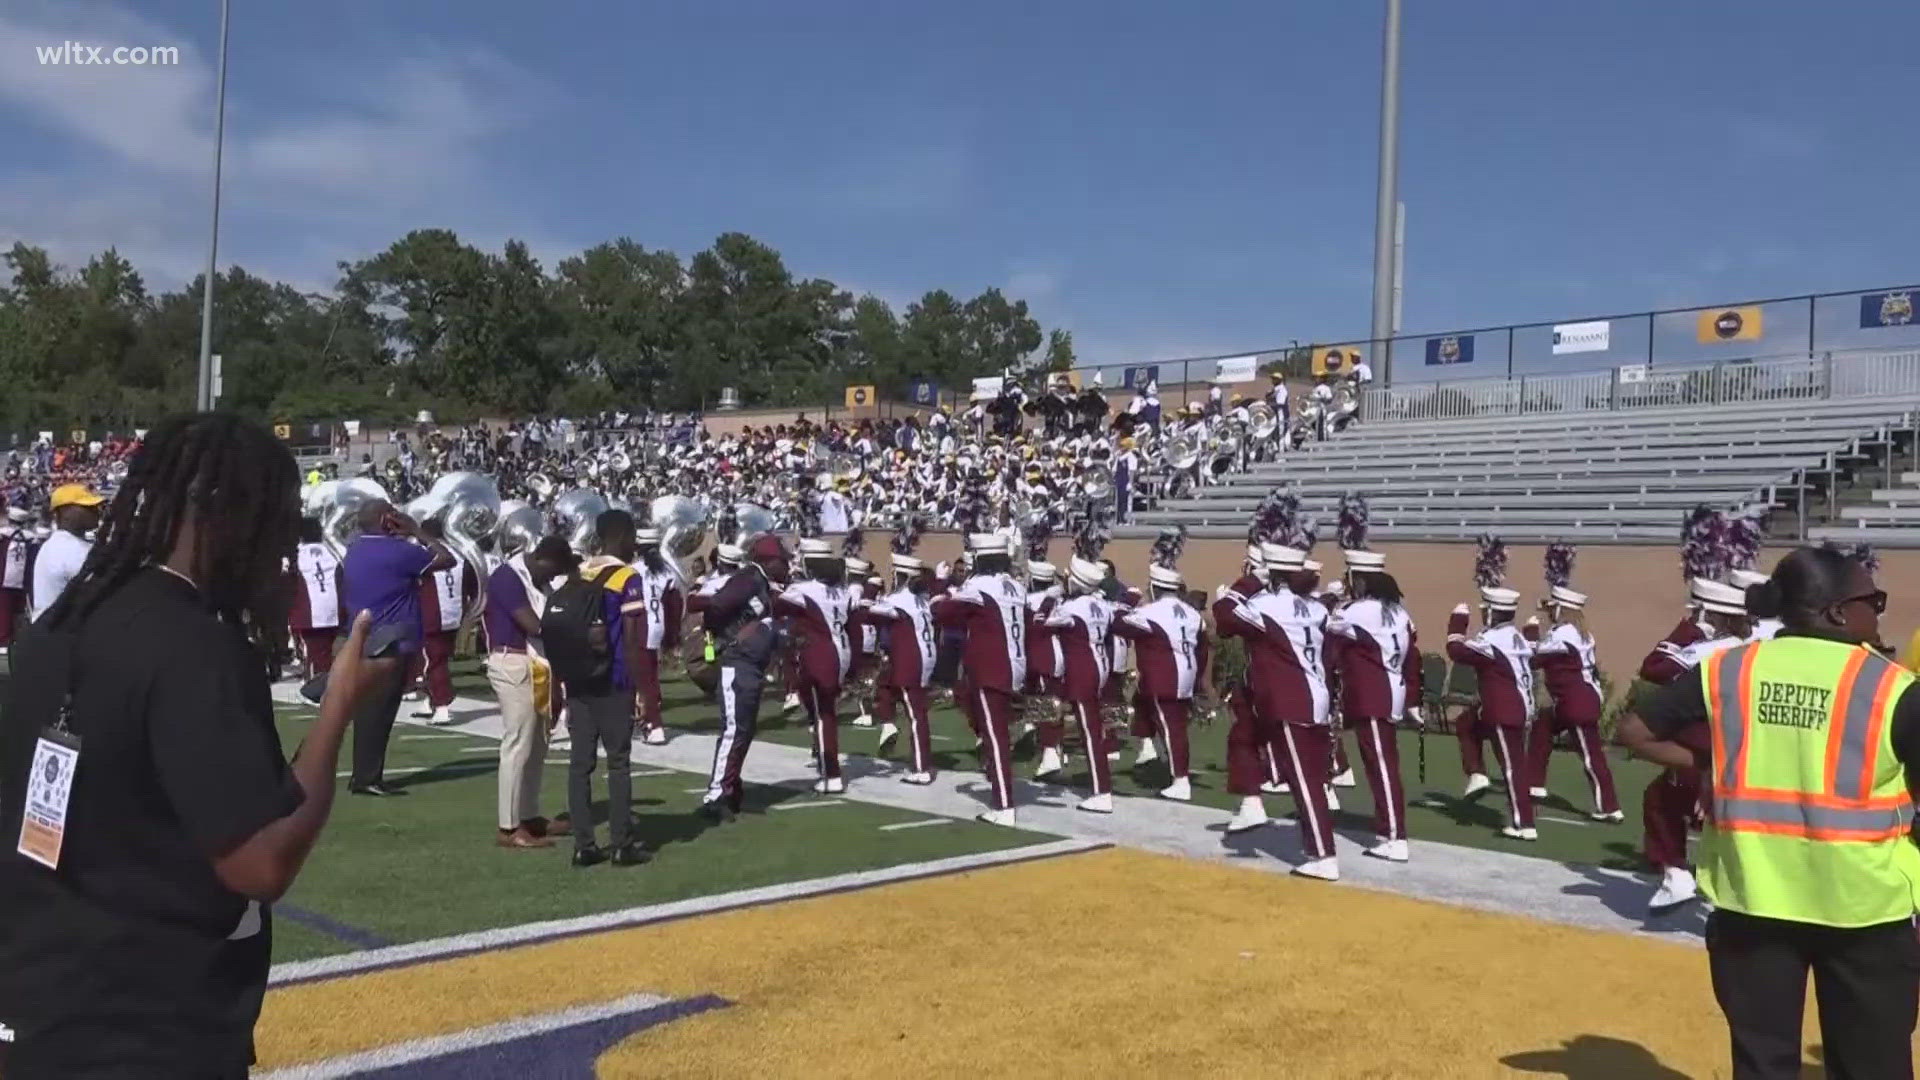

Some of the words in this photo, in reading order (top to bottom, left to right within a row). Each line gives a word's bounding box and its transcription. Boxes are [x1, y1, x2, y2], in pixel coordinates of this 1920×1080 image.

[445, 569, 455, 599] 01
[650, 584, 660, 624] 101
[1010, 605, 1022, 658] 101
[1094, 626, 1107, 672] 101
[1181, 626, 1192, 670] 101
[1759, 681, 1831, 709] DEPUTY
[1758, 703, 1827, 730] SHERIFF
